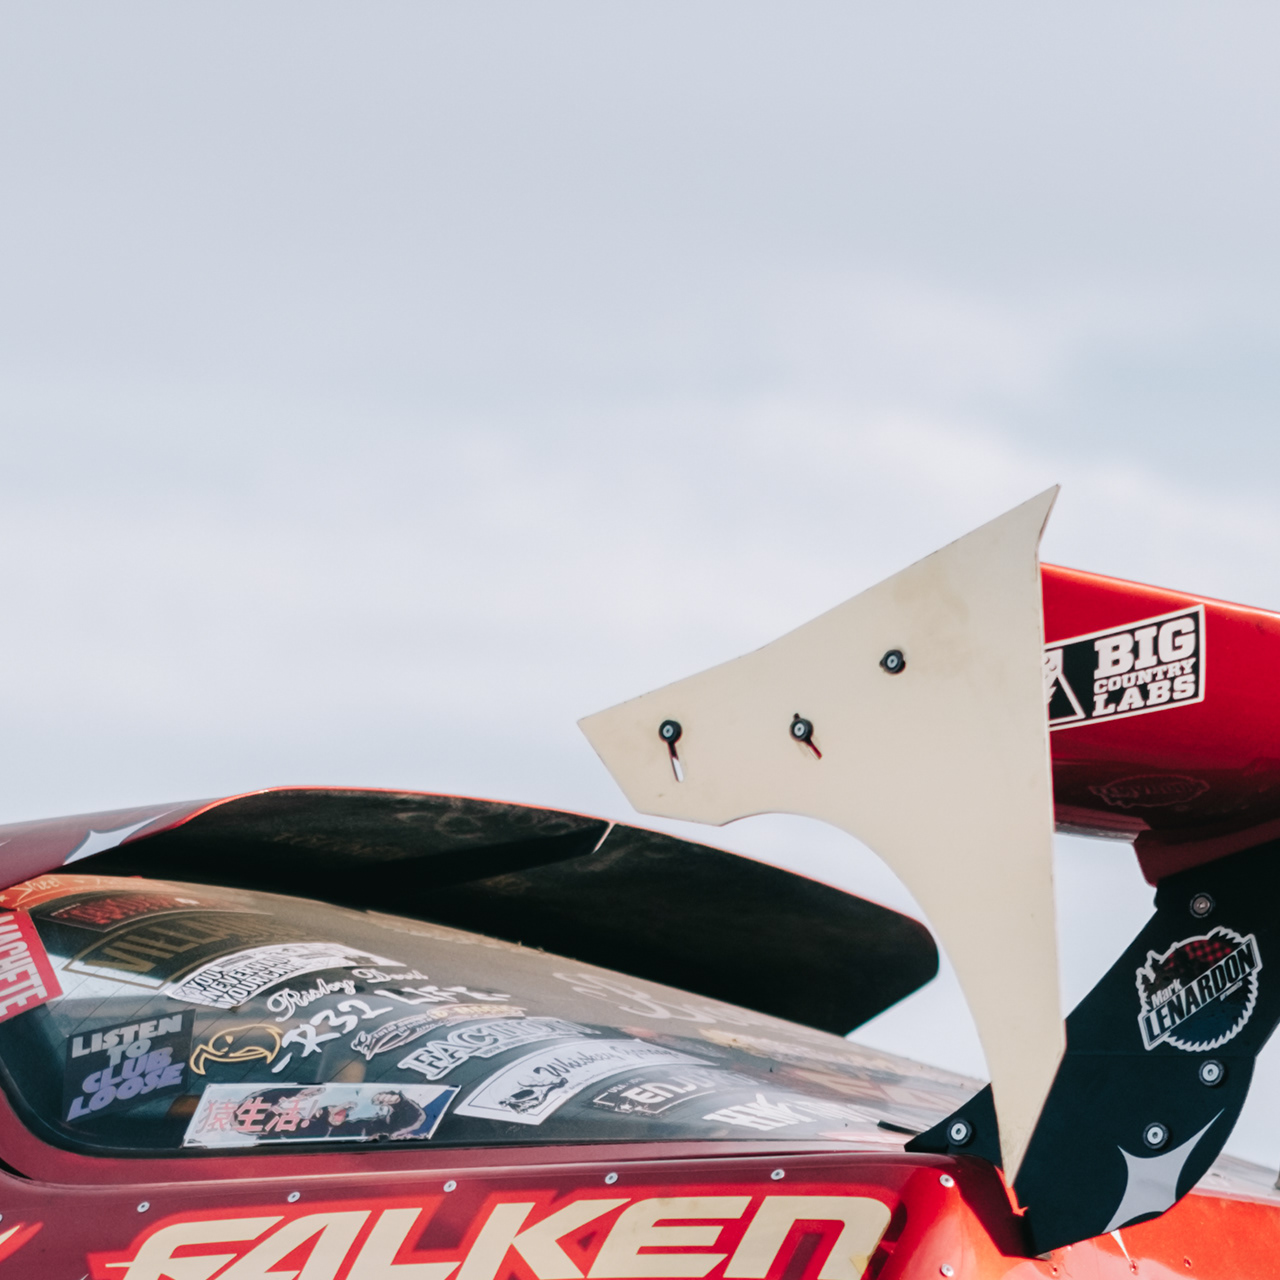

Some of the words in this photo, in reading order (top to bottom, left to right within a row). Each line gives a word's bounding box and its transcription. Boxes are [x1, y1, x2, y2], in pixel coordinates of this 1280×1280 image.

[1093, 616, 1197, 680] BIG
[1091, 674, 1197, 717] LABS
[1093, 656, 1197, 695] COUNTRY
[187, 966, 223, 991] YOU
[1143, 944, 1258, 1043] LENARDON
[1150, 978, 1183, 1009] Mark
[71, 1014, 183, 1059] LISTEN
[106, 1038, 152, 1068] TO
[66, 1062, 186, 1122] LOOSE
[81, 1046, 173, 1094] CLUB
